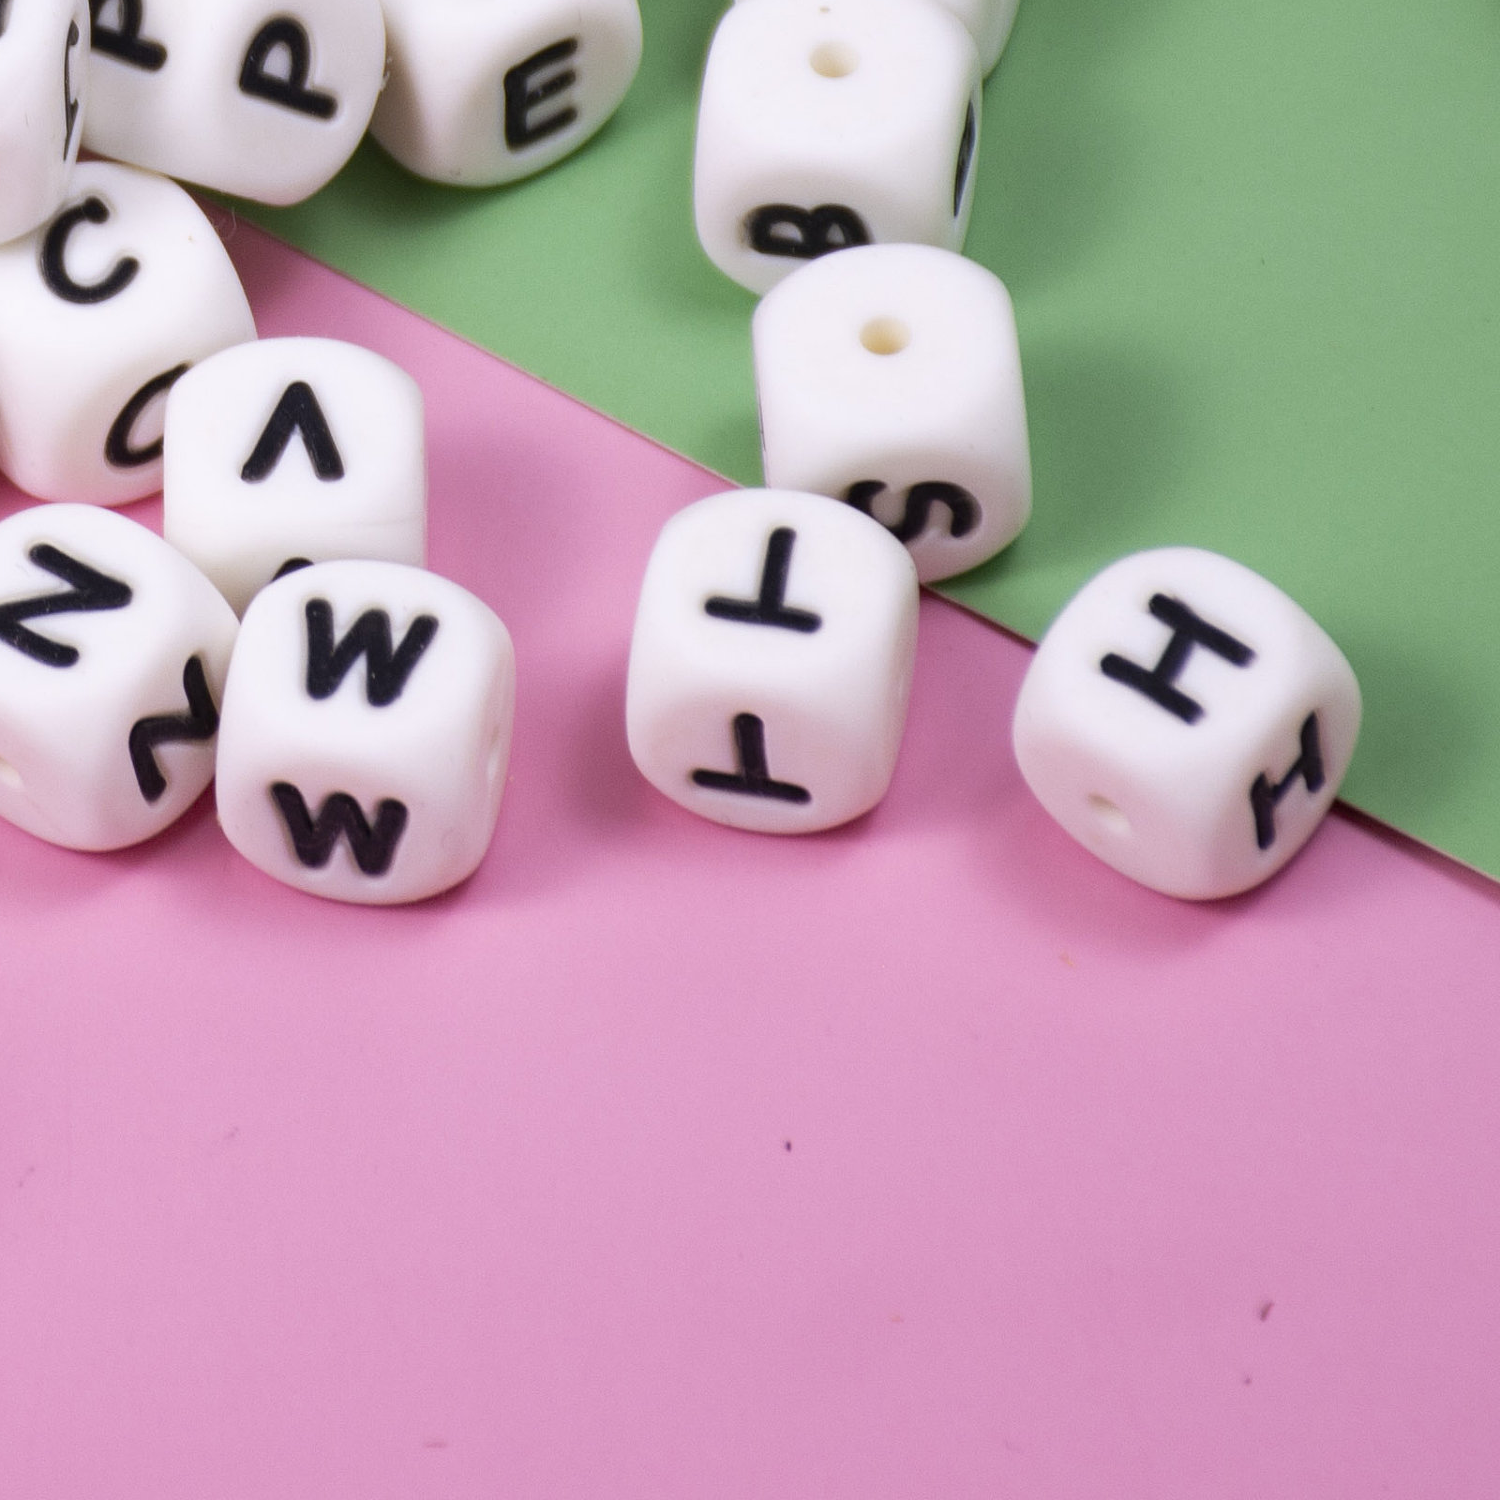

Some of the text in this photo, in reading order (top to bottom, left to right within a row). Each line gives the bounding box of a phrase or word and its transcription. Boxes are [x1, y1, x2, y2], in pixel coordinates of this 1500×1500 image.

[237, 15, 338, 121] P
[501, 36, 580, 153] E
[41, 196, 139, 305] C
[742, 202, 872, 261] B
[846, 478, 982, 542] S
[703, 527, 821, 634] T
[304, 598, 439, 708] W
[1099, 592, 1254, 724] H
[689, 711, 812, 805] T
[1248, 709, 1327, 852] H
[268, 780, 409, 878] W
